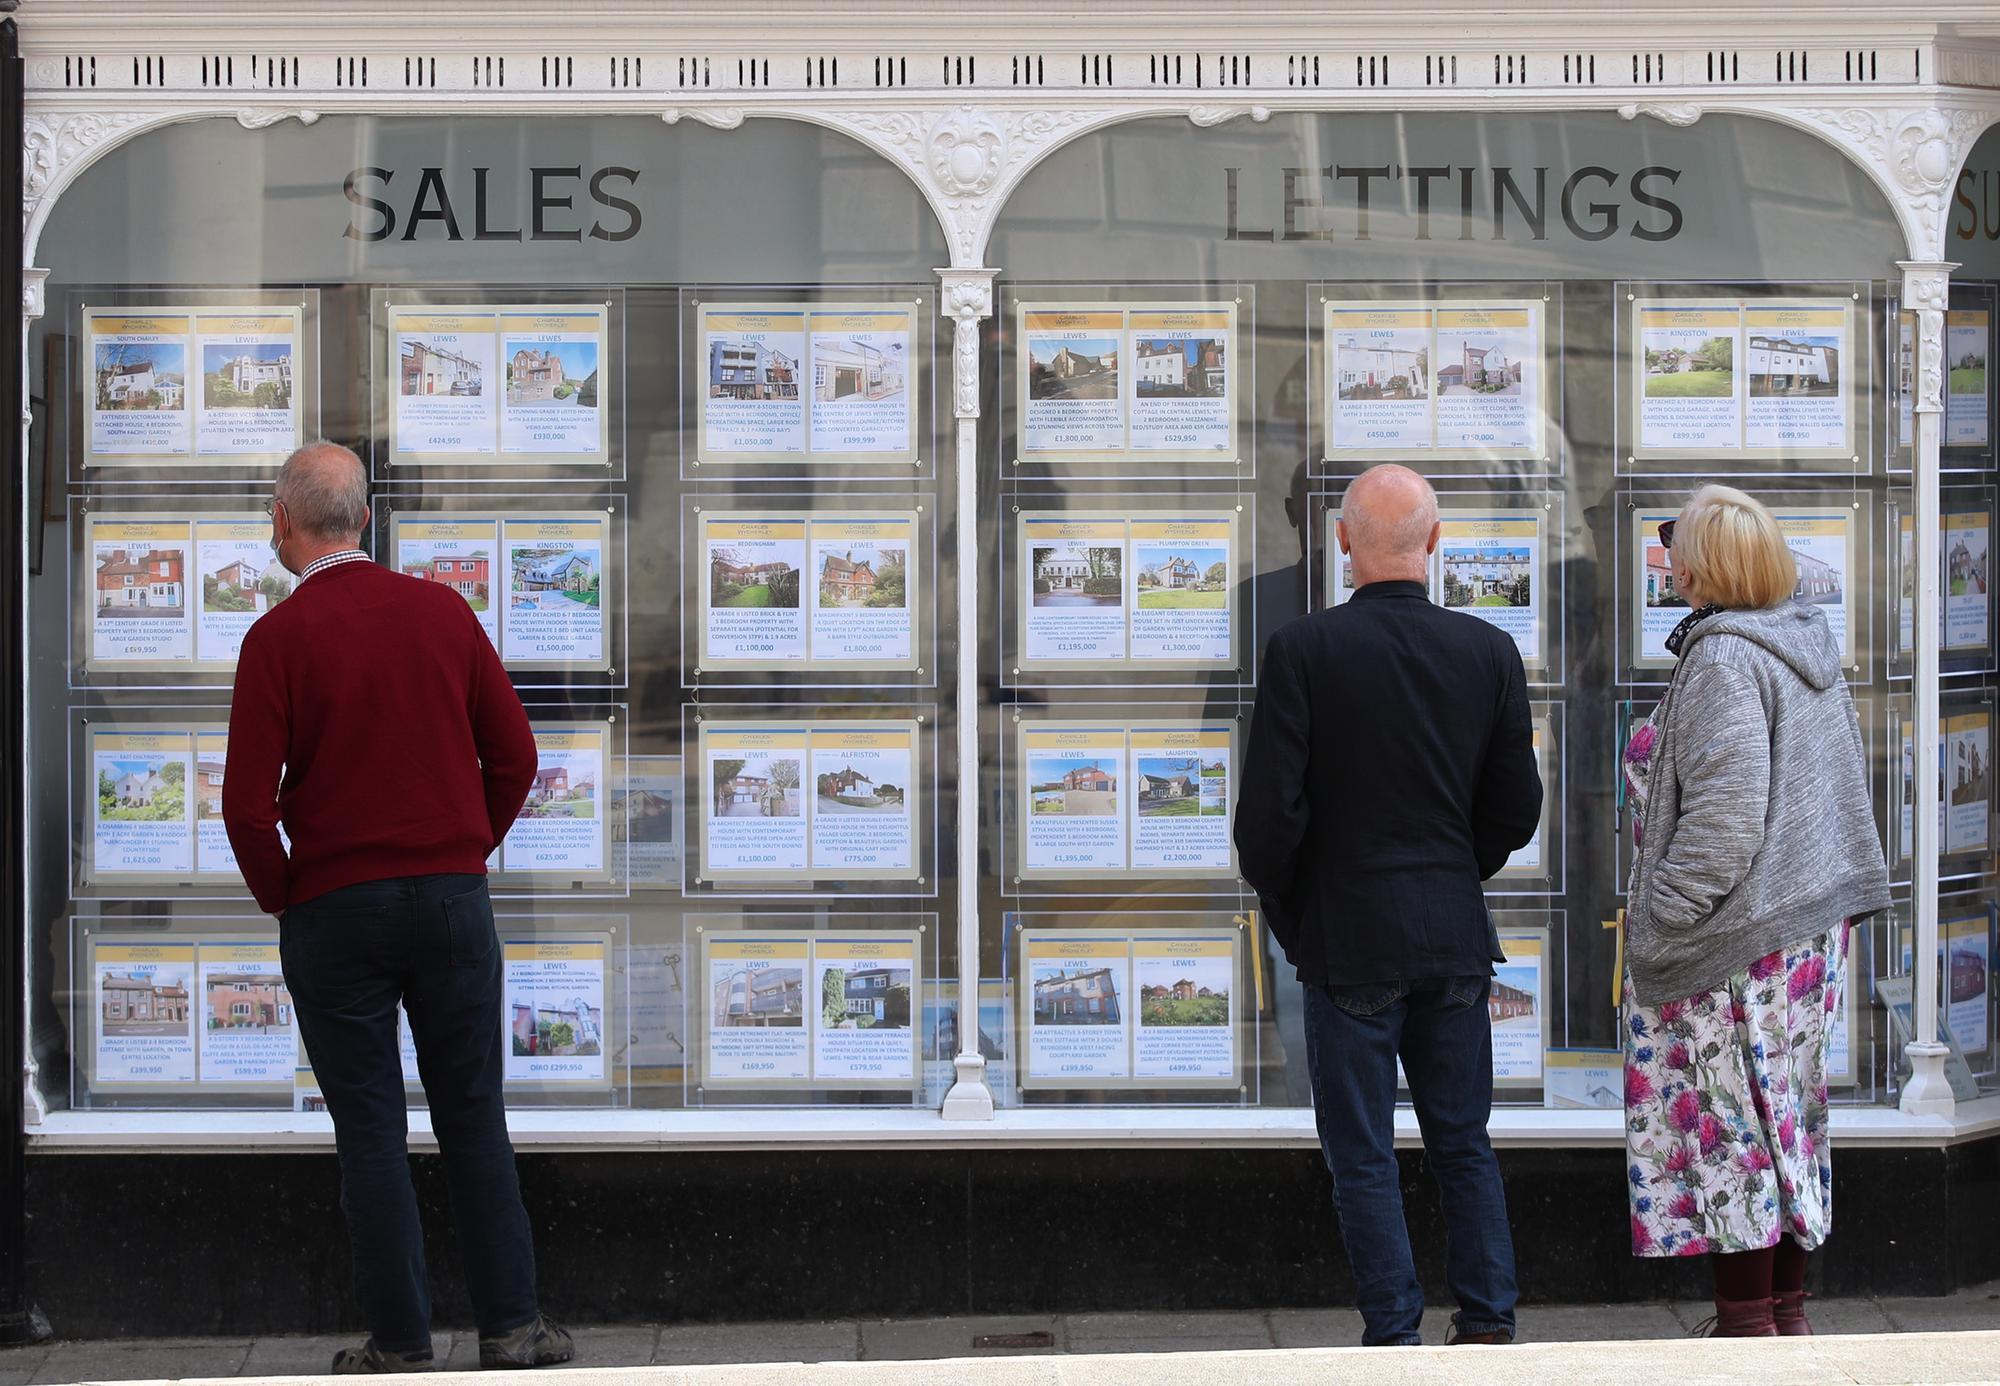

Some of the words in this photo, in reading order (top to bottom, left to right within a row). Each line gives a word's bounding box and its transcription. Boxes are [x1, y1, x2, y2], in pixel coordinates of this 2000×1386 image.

[343, 166, 642, 242] SALES
[1224, 165, 1683, 242] LETTINGS
[1367, 431, 1399, 439] £450,000
[232, 438, 264, 446] £899,950
[734, 438, 772, 446] £1,050,000
[536, 644, 574, 652] £1,500,000
[735, 644, 774, 652] £1,100,000
[1058, 643, 1096, 651] £1,195,000
[745, 751, 768, 759] LEWES
[536, 853, 568, 861] £625,000
[738, 855, 776, 863] £1,100,000
[1163, 854, 1202, 862] £2,200,000
[1169, 1064, 1201, 1072] £499,950
[1584, 1070, 1609, 1078] LEWES
